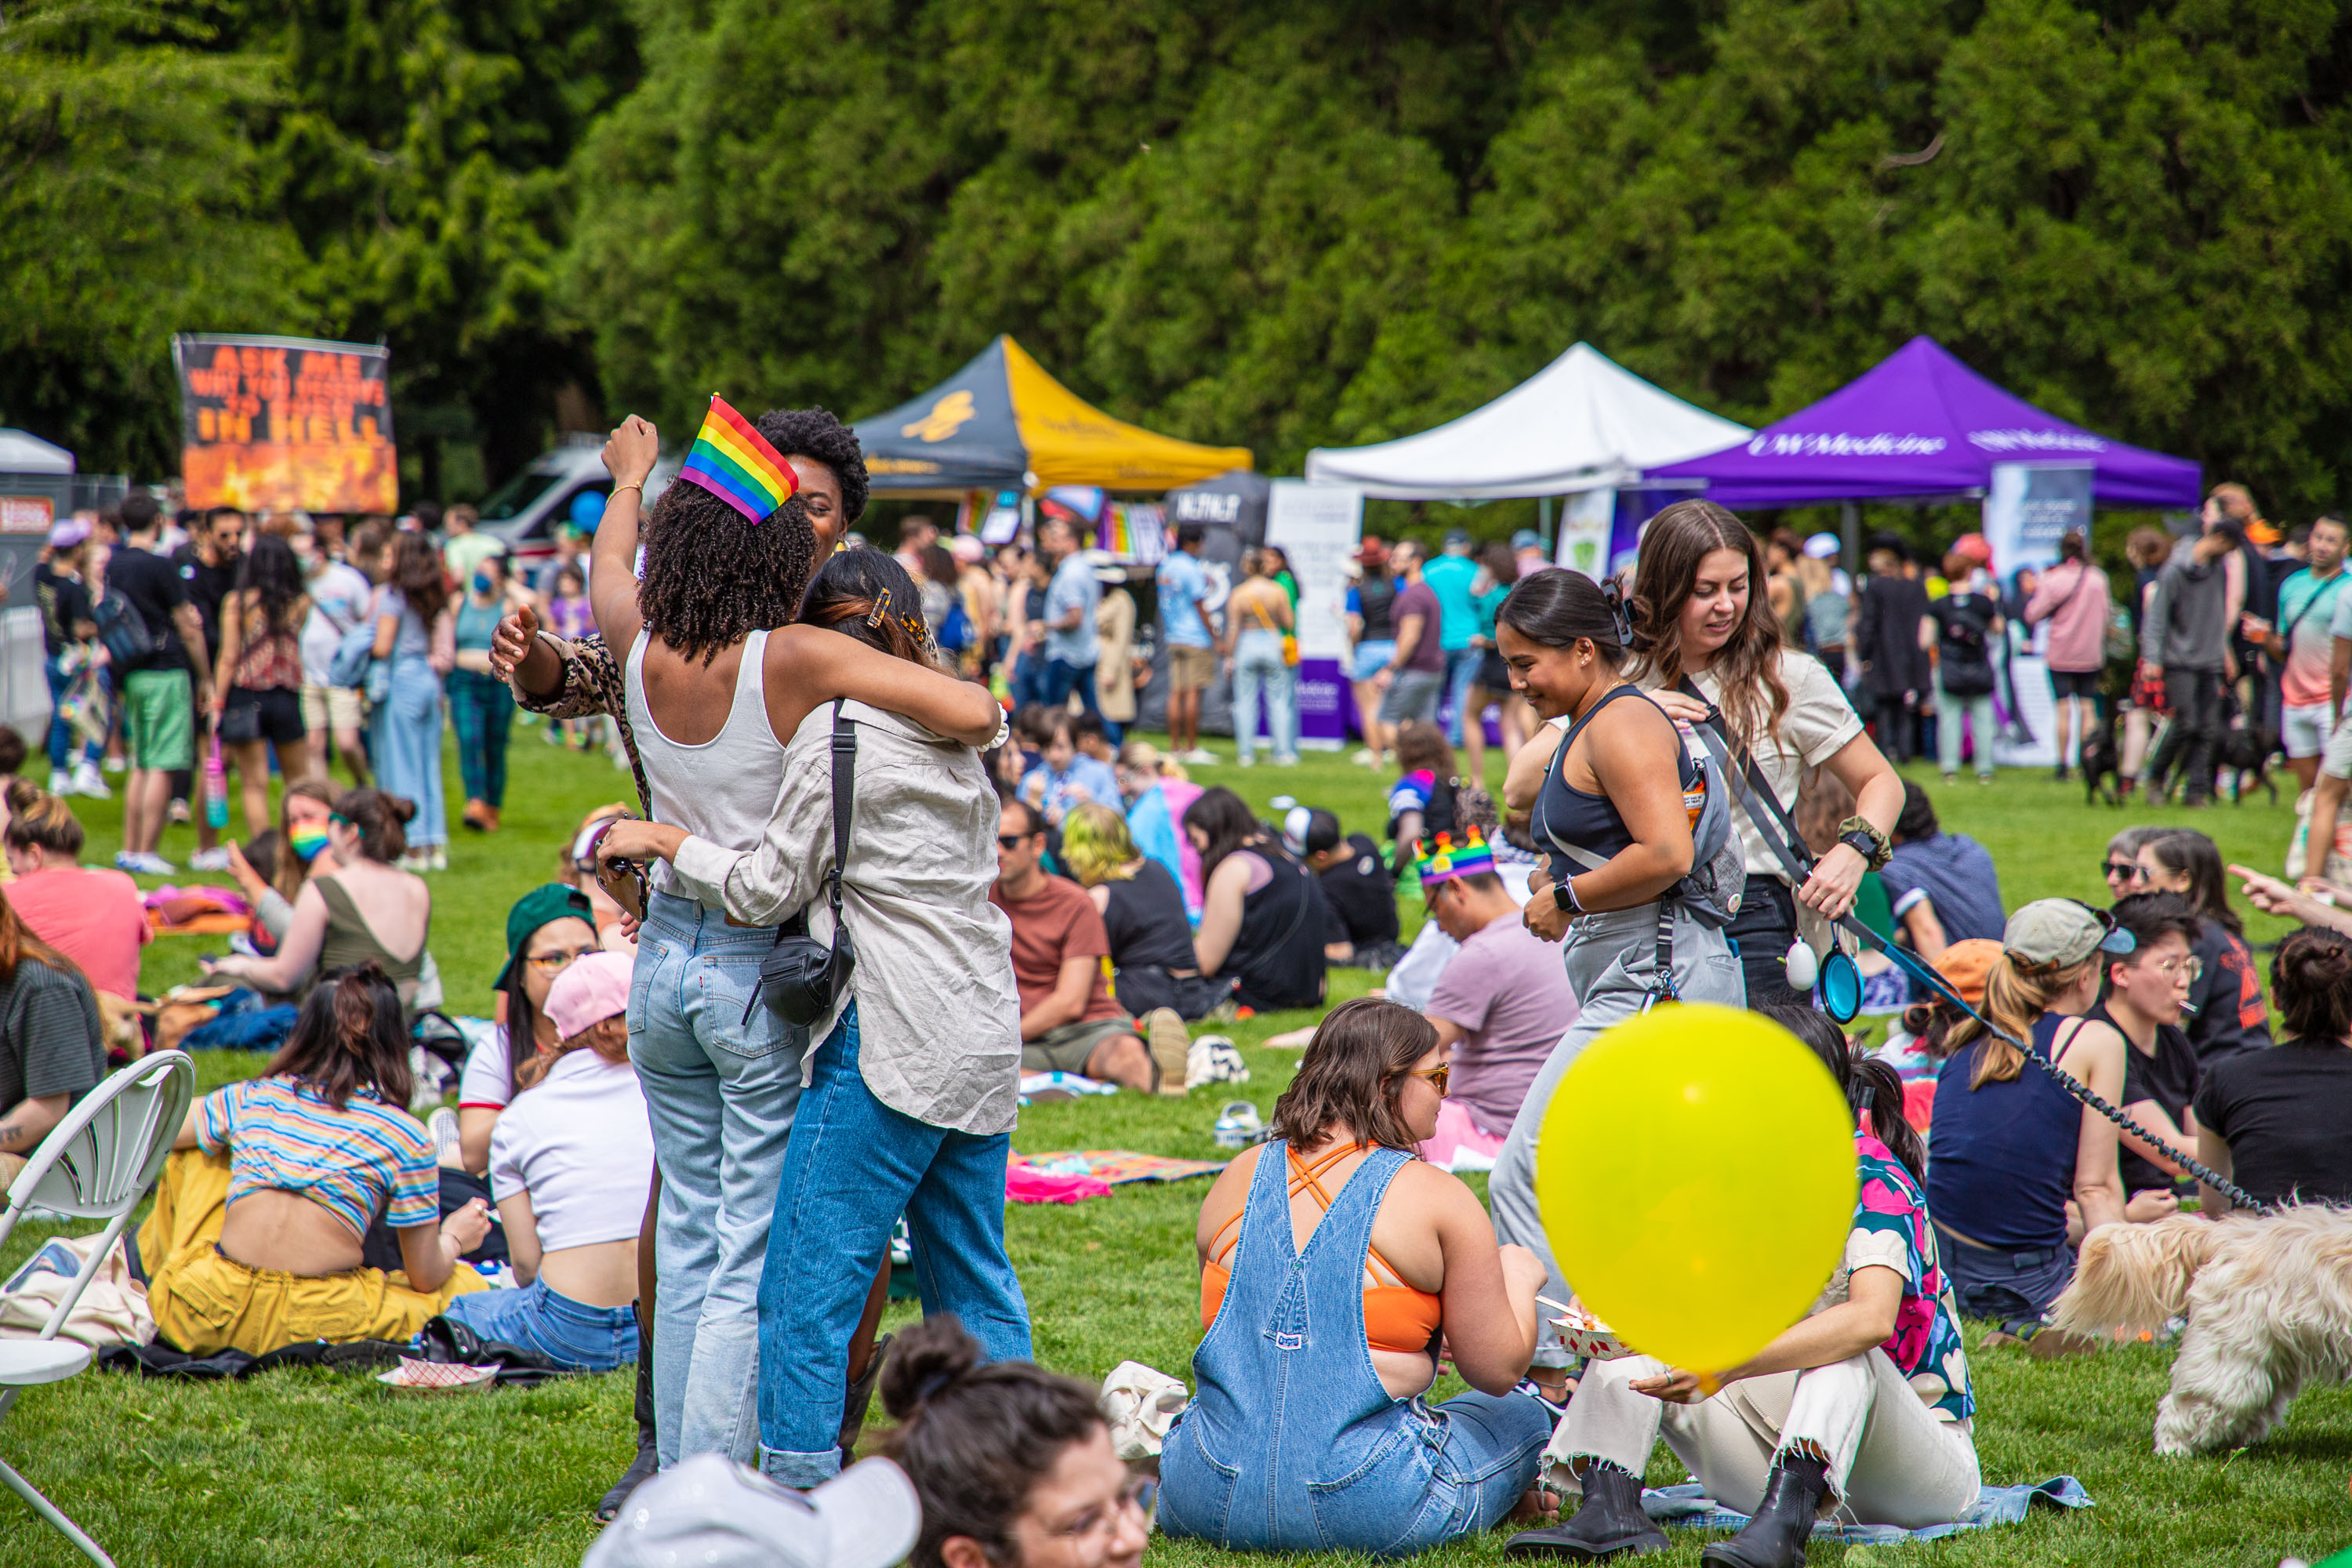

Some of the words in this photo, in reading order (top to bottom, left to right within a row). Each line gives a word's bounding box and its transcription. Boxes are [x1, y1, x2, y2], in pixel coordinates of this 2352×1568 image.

[212, 345, 288, 377] ASK
[301, 350, 361, 379] ME
[198, 406, 252, 444] IN
[269, 413, 387, 449] HELL
[1805, 432, 1947, 456] Medicine
